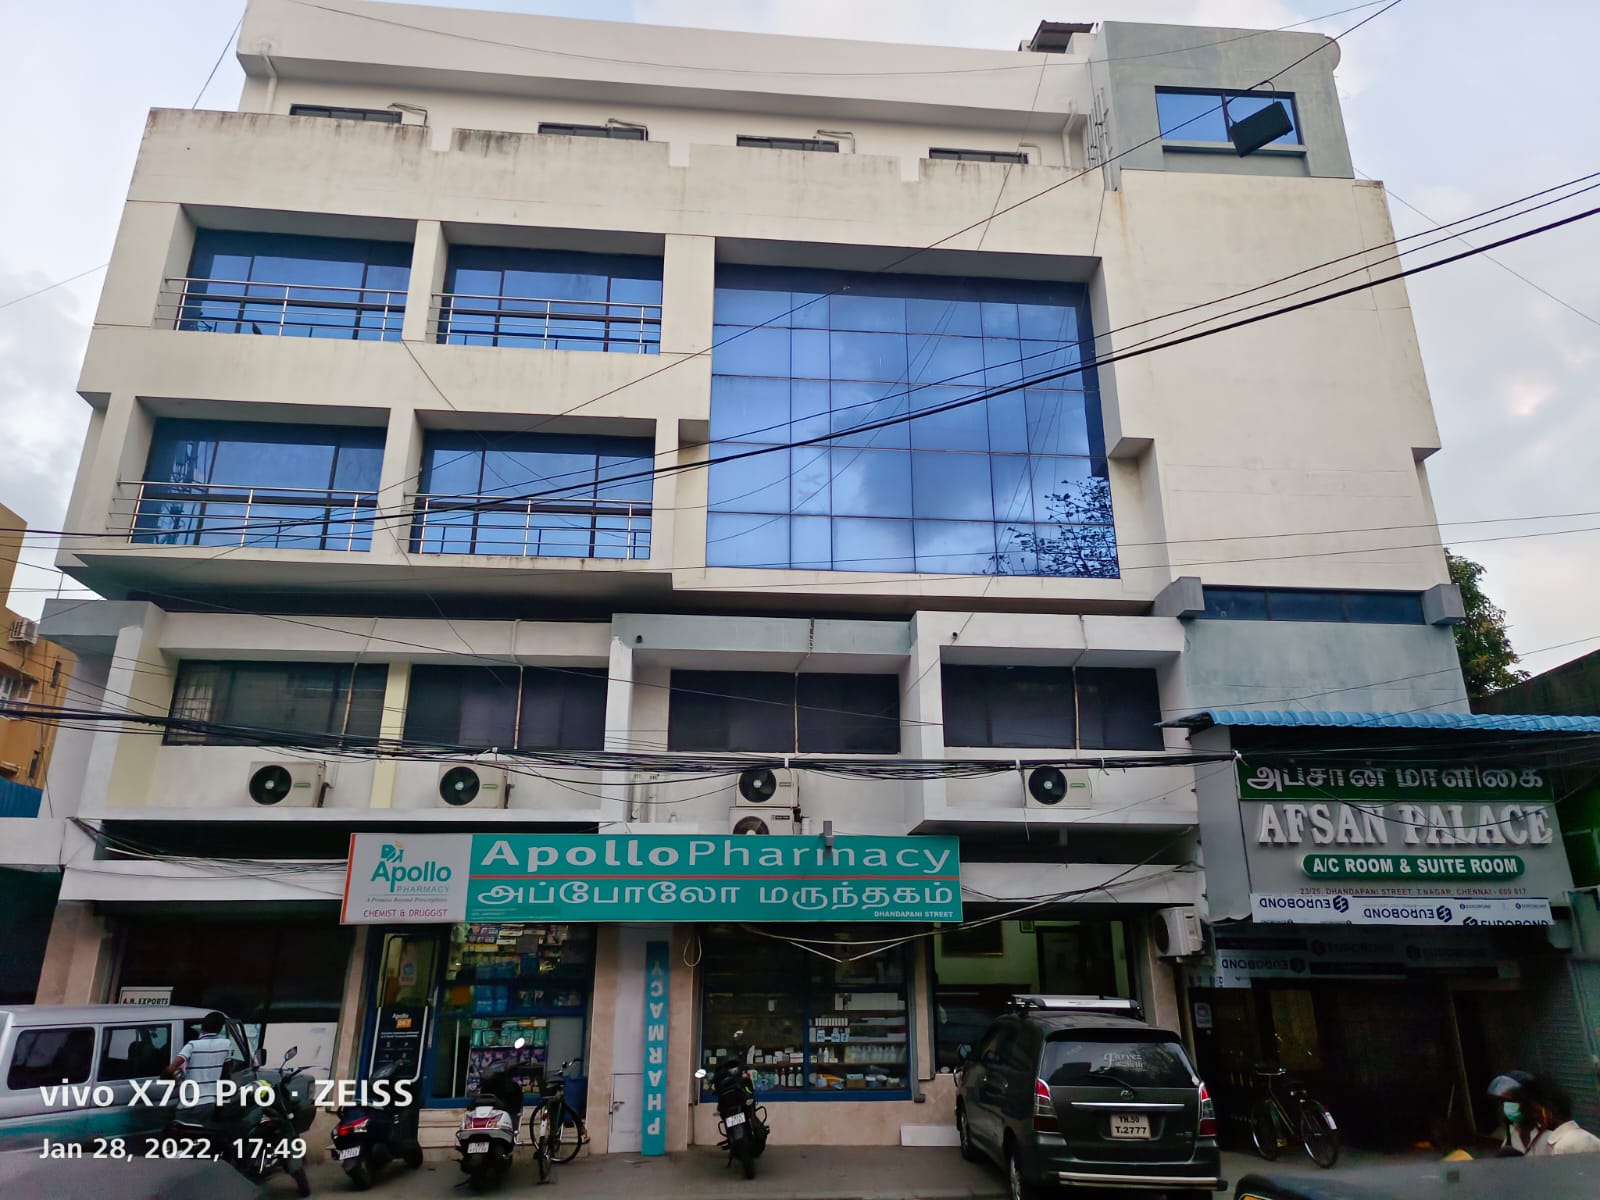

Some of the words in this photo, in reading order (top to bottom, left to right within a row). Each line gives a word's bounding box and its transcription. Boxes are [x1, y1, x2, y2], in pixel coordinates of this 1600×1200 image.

[1259, 804, 1388, 844] AFSAN
[1398, 804, 1552, 845] PALACE
[1313, 858, 1340, 873] A/C
[1345, 858, 1393, 873] ROOM
[1400, 859, 1412, 873] &
[1416, 858, 1466, 874] SUITE
[1471, 858, 1518, 873] ROOM
[370, 861, 452, 893] Apollo
[396, 885, 449, 893] PHARMACY
[477, 881, 741, 905] அப்போலோ
[759, 881, 953, 910] மருந்தகம்
[1259, 898, 1331, 909] EUROBOND
[363, 909, 397, 918] CHEMIST
[408, 908, 449, 917] DRUGGIST
[1363, 908, 1435, 919] EUROBOND
[646, 959, 665, 1135] PHARMACY
[1115, 1126, 1147, 1134] T.2777
